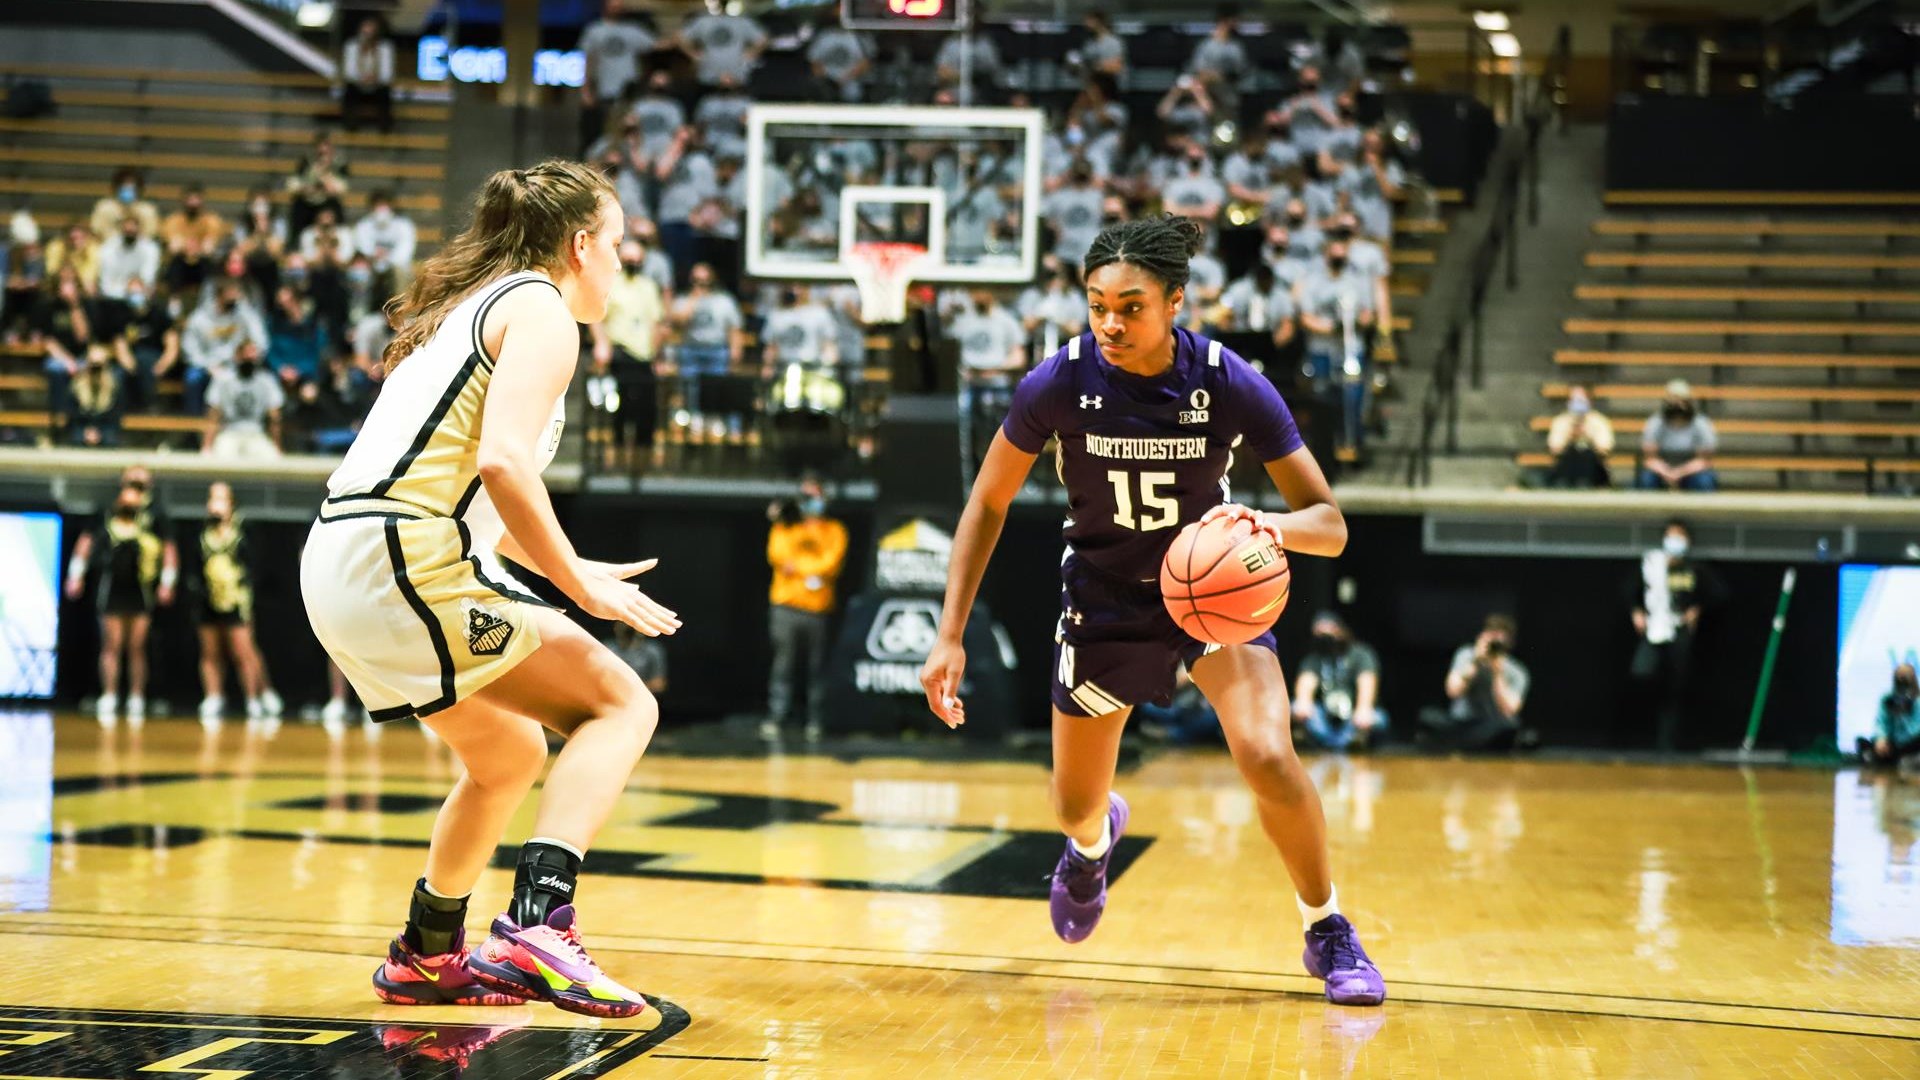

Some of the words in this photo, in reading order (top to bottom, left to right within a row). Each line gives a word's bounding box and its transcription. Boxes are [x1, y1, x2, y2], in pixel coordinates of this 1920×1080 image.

[1085, 432, 1207, 460] NORTHWESTERN
[1107, 470, 1179, 532] 15
[472, 623, 511, 653] PURDUE
